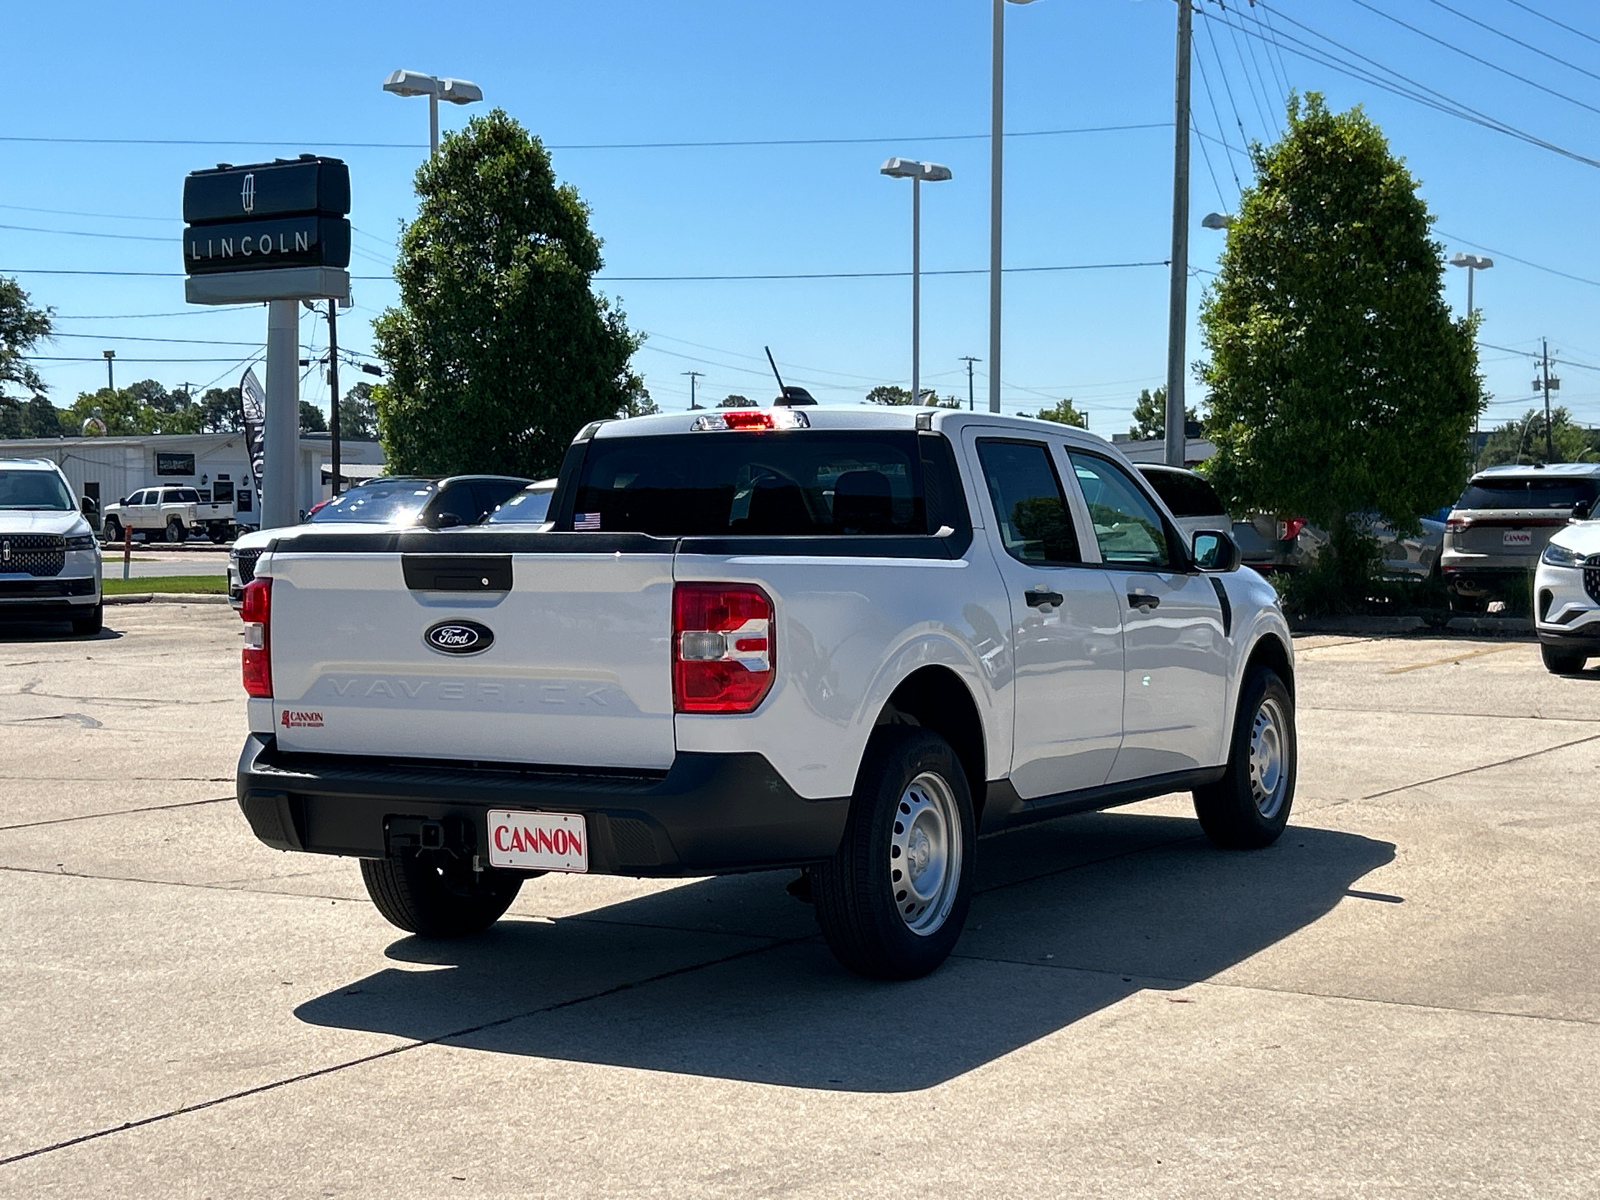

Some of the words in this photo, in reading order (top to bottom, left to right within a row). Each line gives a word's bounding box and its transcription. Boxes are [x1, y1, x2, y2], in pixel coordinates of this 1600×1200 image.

[192, 231, 309, 260] LINCOLN
[1504, 533, 1530, 542] CANNON
[438, 628, 469, 644] Ford
[327, 677, 608, 707] MAVERICK
[290, 711, 324, 722] CANNON
[494, 825, 582, 857] CANNON
